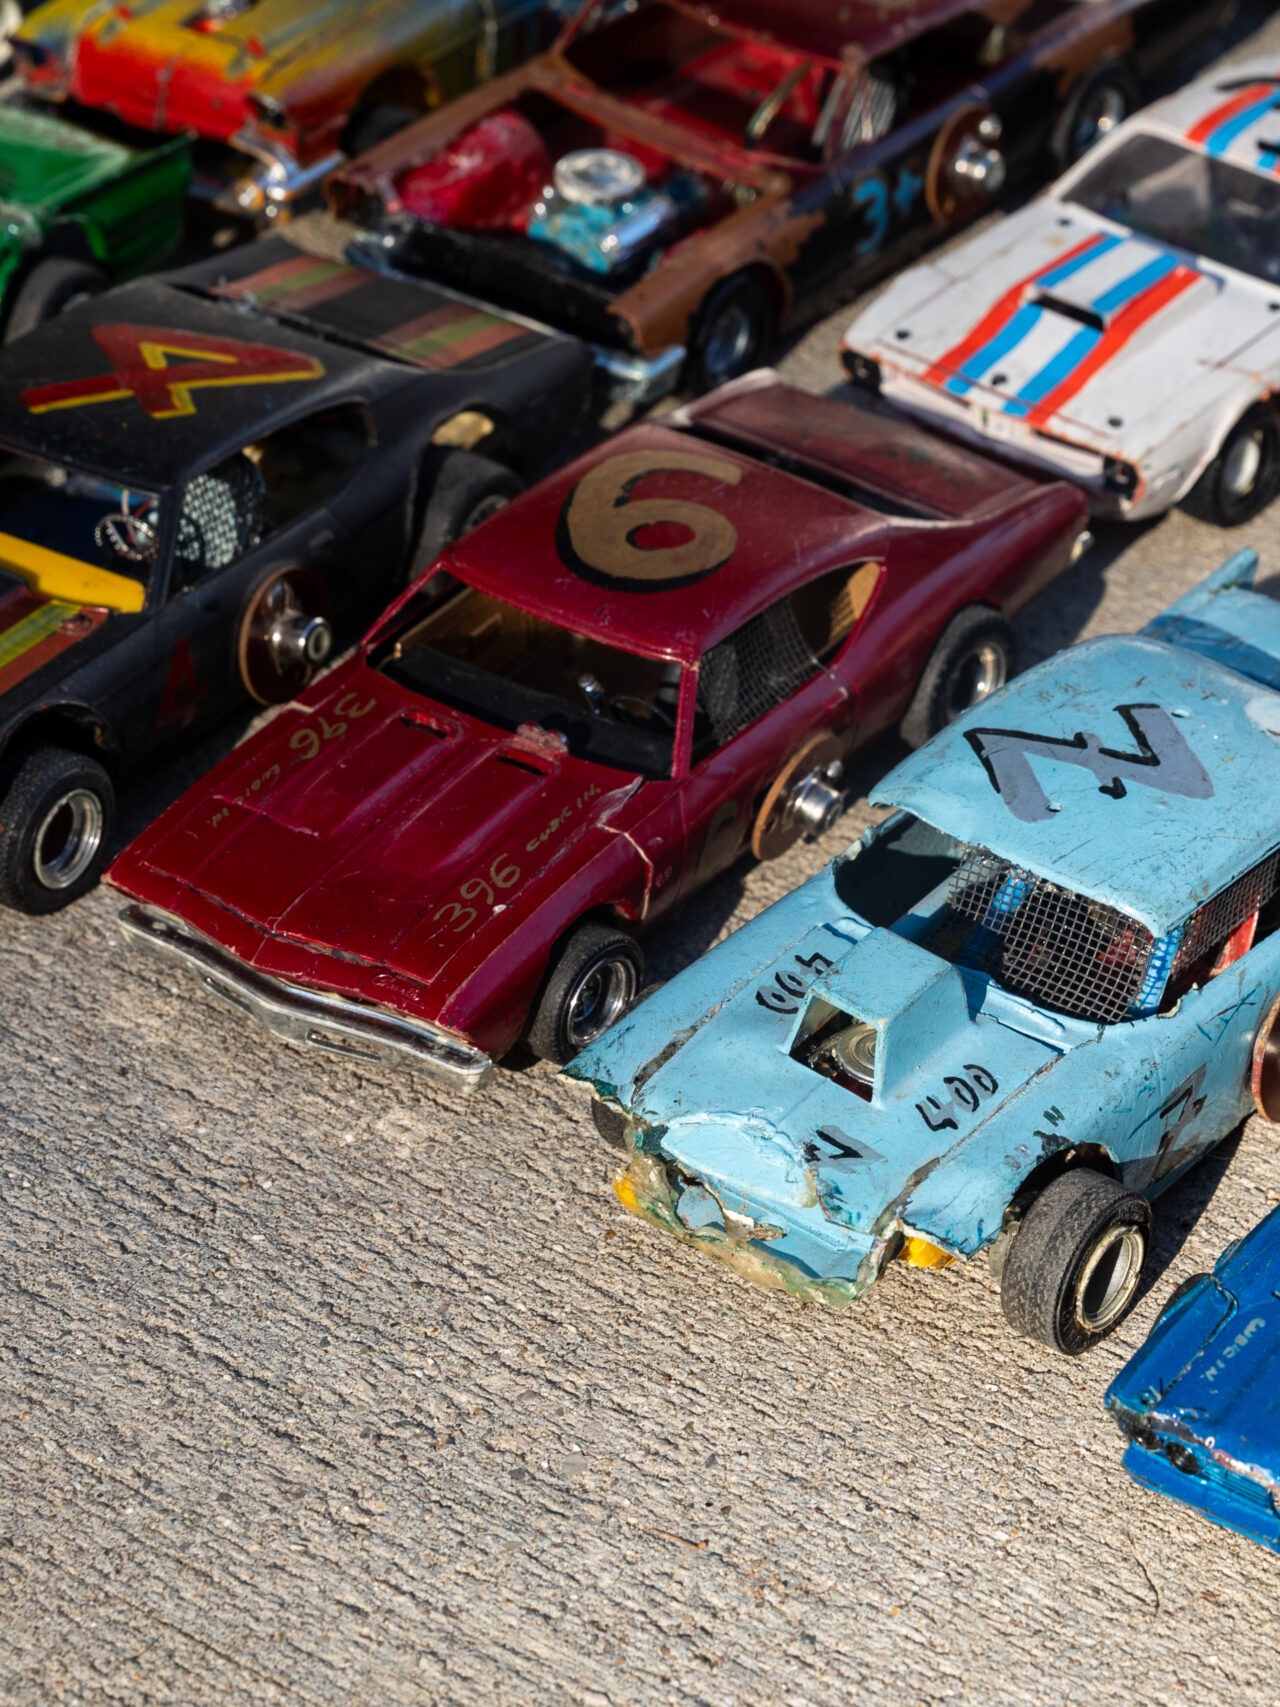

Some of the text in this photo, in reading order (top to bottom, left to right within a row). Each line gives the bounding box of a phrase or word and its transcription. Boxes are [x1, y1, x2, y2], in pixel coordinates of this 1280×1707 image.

[20, 324, 325, 418] 4
[289, 692, 377, 759] 396
[432, 853, 521, 932] 396
[755, 951, 835, 1015] 400
[915, 1063, 998, 1132] 400
